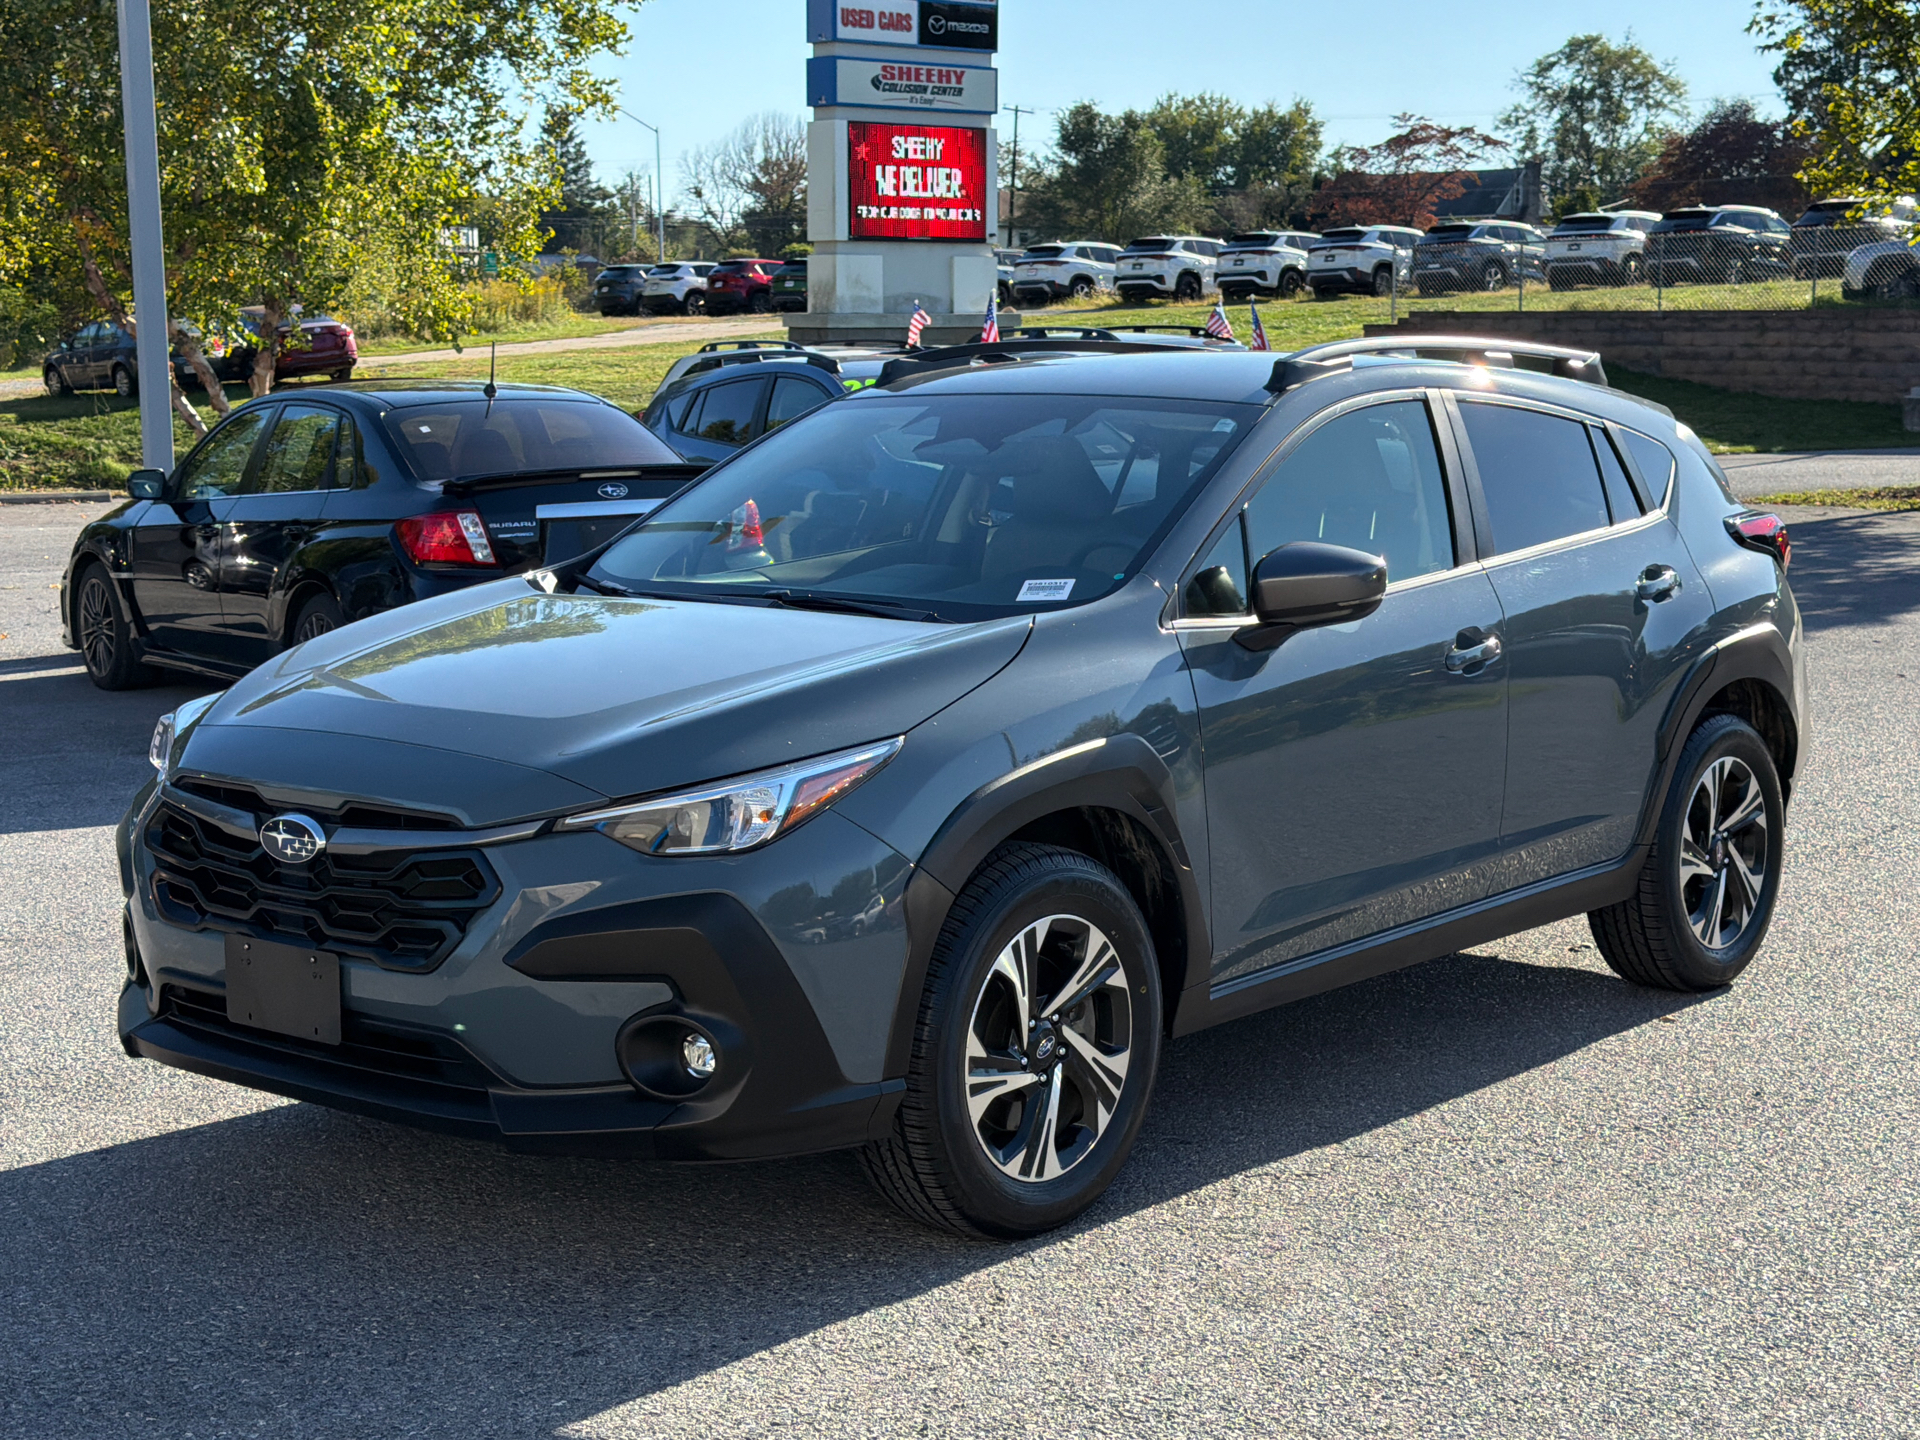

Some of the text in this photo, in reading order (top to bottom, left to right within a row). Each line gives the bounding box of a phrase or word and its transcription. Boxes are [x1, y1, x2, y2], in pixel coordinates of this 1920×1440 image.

[841, 7, 913, 32] USED CARS
[881, 65, 966, 85] SHEEHY
[882, 82, 964, 97] COLLISION CENTER
[891, 135, 945, 160] SHEEHY
